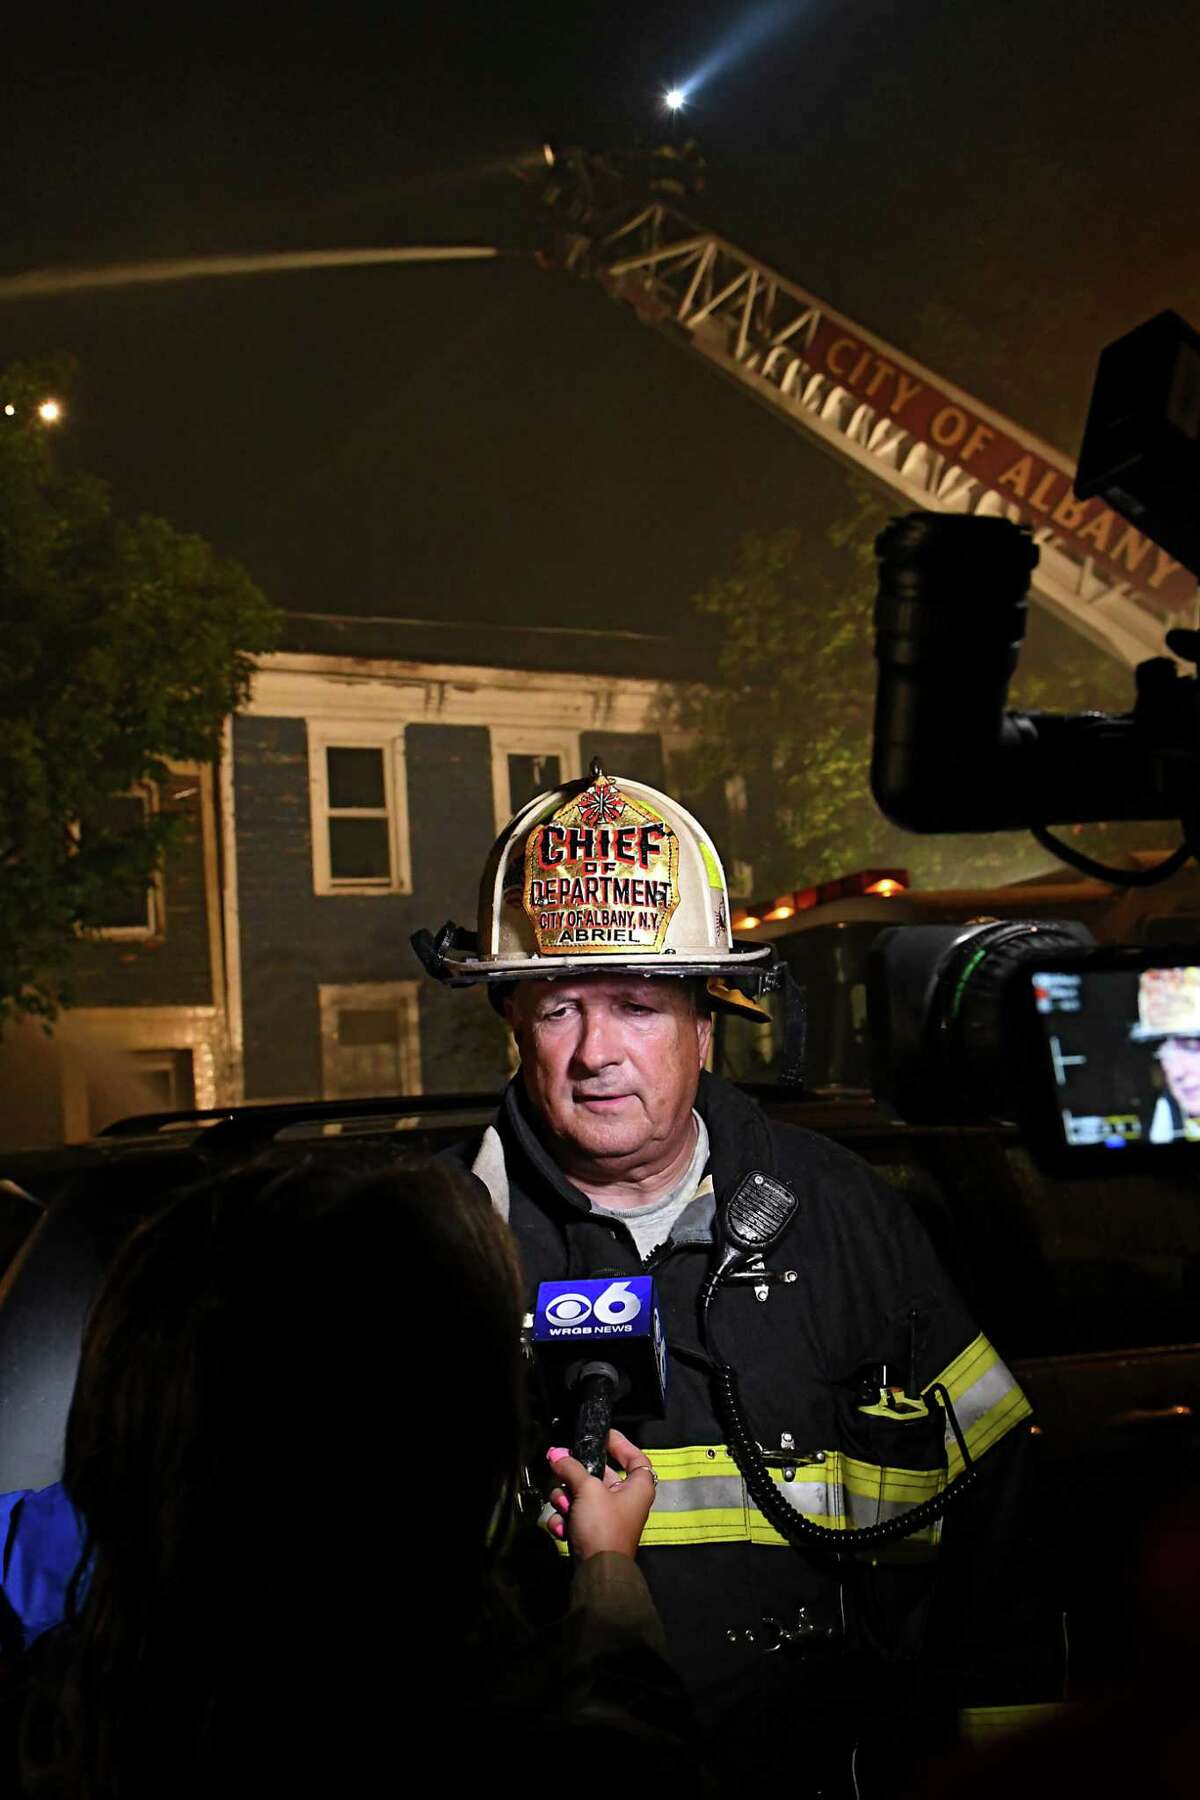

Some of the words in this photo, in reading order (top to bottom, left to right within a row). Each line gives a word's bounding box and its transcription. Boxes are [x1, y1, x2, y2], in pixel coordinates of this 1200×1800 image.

[826, 339, 922, 412] CITY
[931, 407, 995, 462] OF
[998, 454, 1181, 588] ALBANY
[537, 823, 666, 870] CHIEF
[583, 862, 616, 875] OF
[530, 877, 671, 909] DEPARTMENT
[540, 911, 564, 929] CITY
[567, 910, 582, 927] OF
[559, 928, 640, 942] ABRIEL
[593, 1281, 641, 1325] 6
[550, 1327, 592, 1336] WRGB
[594, 1324, 632, 1334] NEWS
